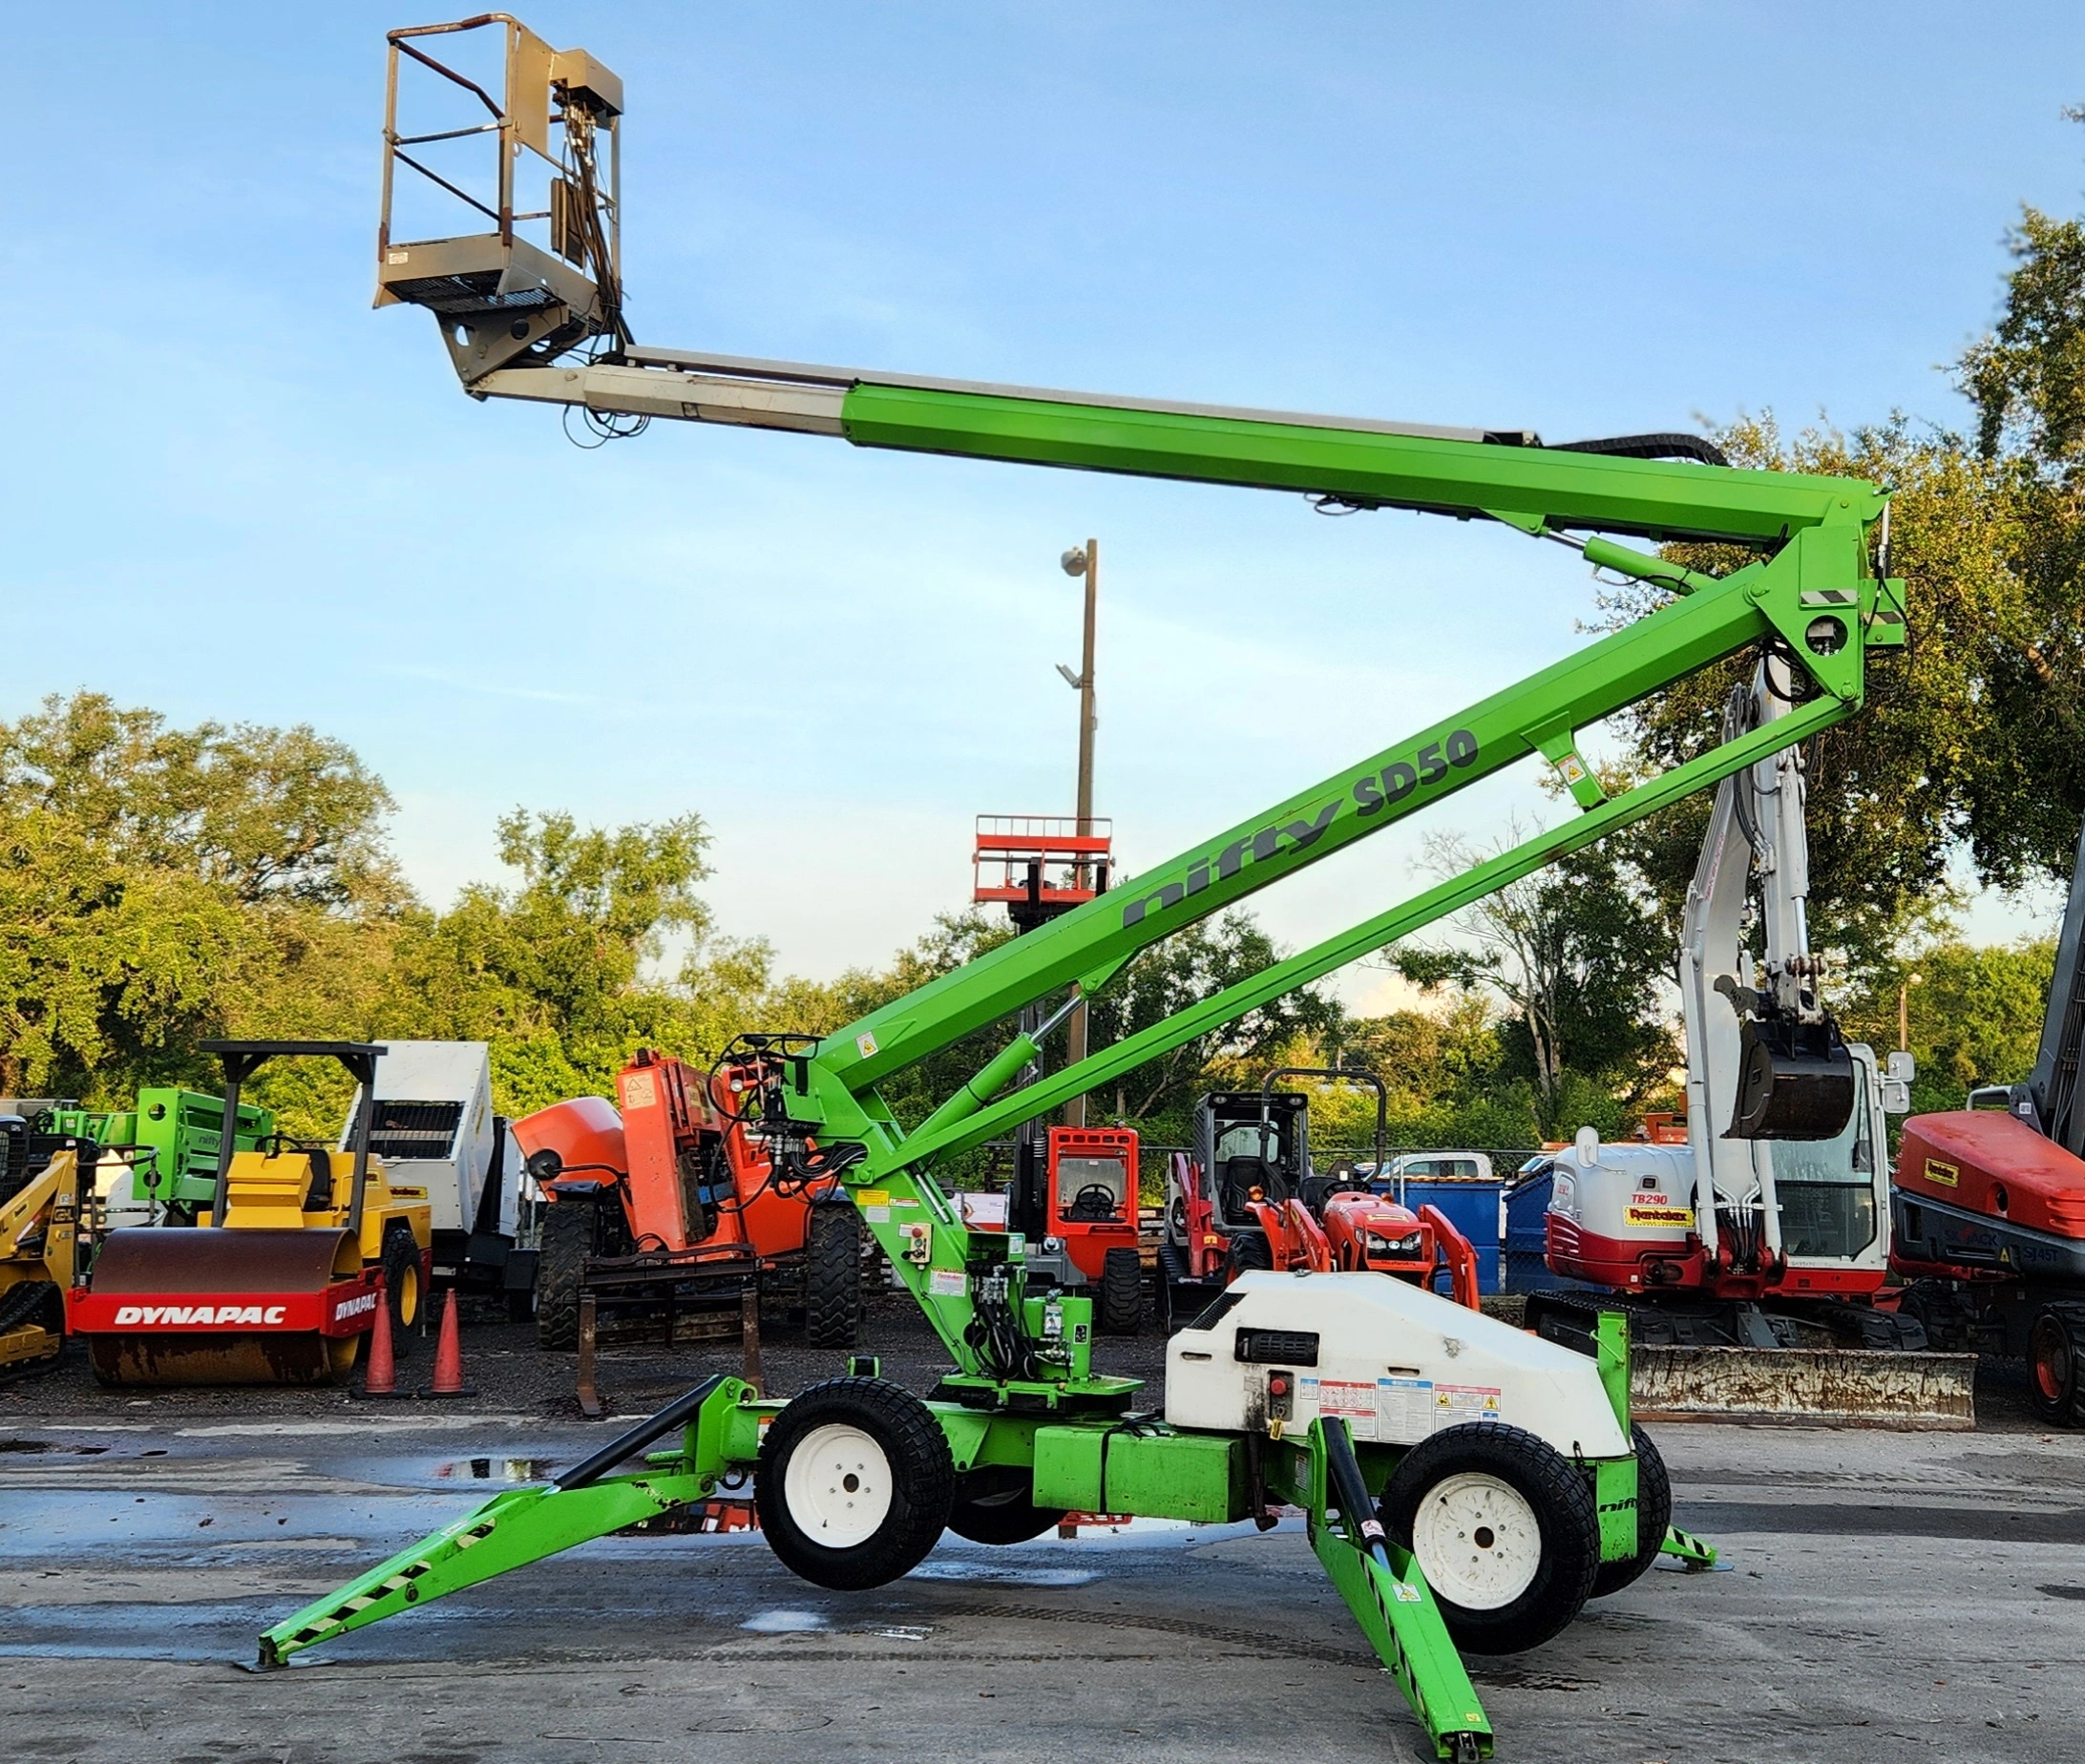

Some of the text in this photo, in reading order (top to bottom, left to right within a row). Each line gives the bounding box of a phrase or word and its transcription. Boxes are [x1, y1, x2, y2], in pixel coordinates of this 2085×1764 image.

[1123, 729, 1479, 928] nifty SD50
[1632, 1194, 1668, 1205] TB290
[1630, 1208, 1688, 1221] Rentalex
[2023, 1247, 2058, 1261] SJ45T
[335, 1292, 377, 1321] DYNAPAC
[115, 1307, 286, 1325] DYNAPAC
